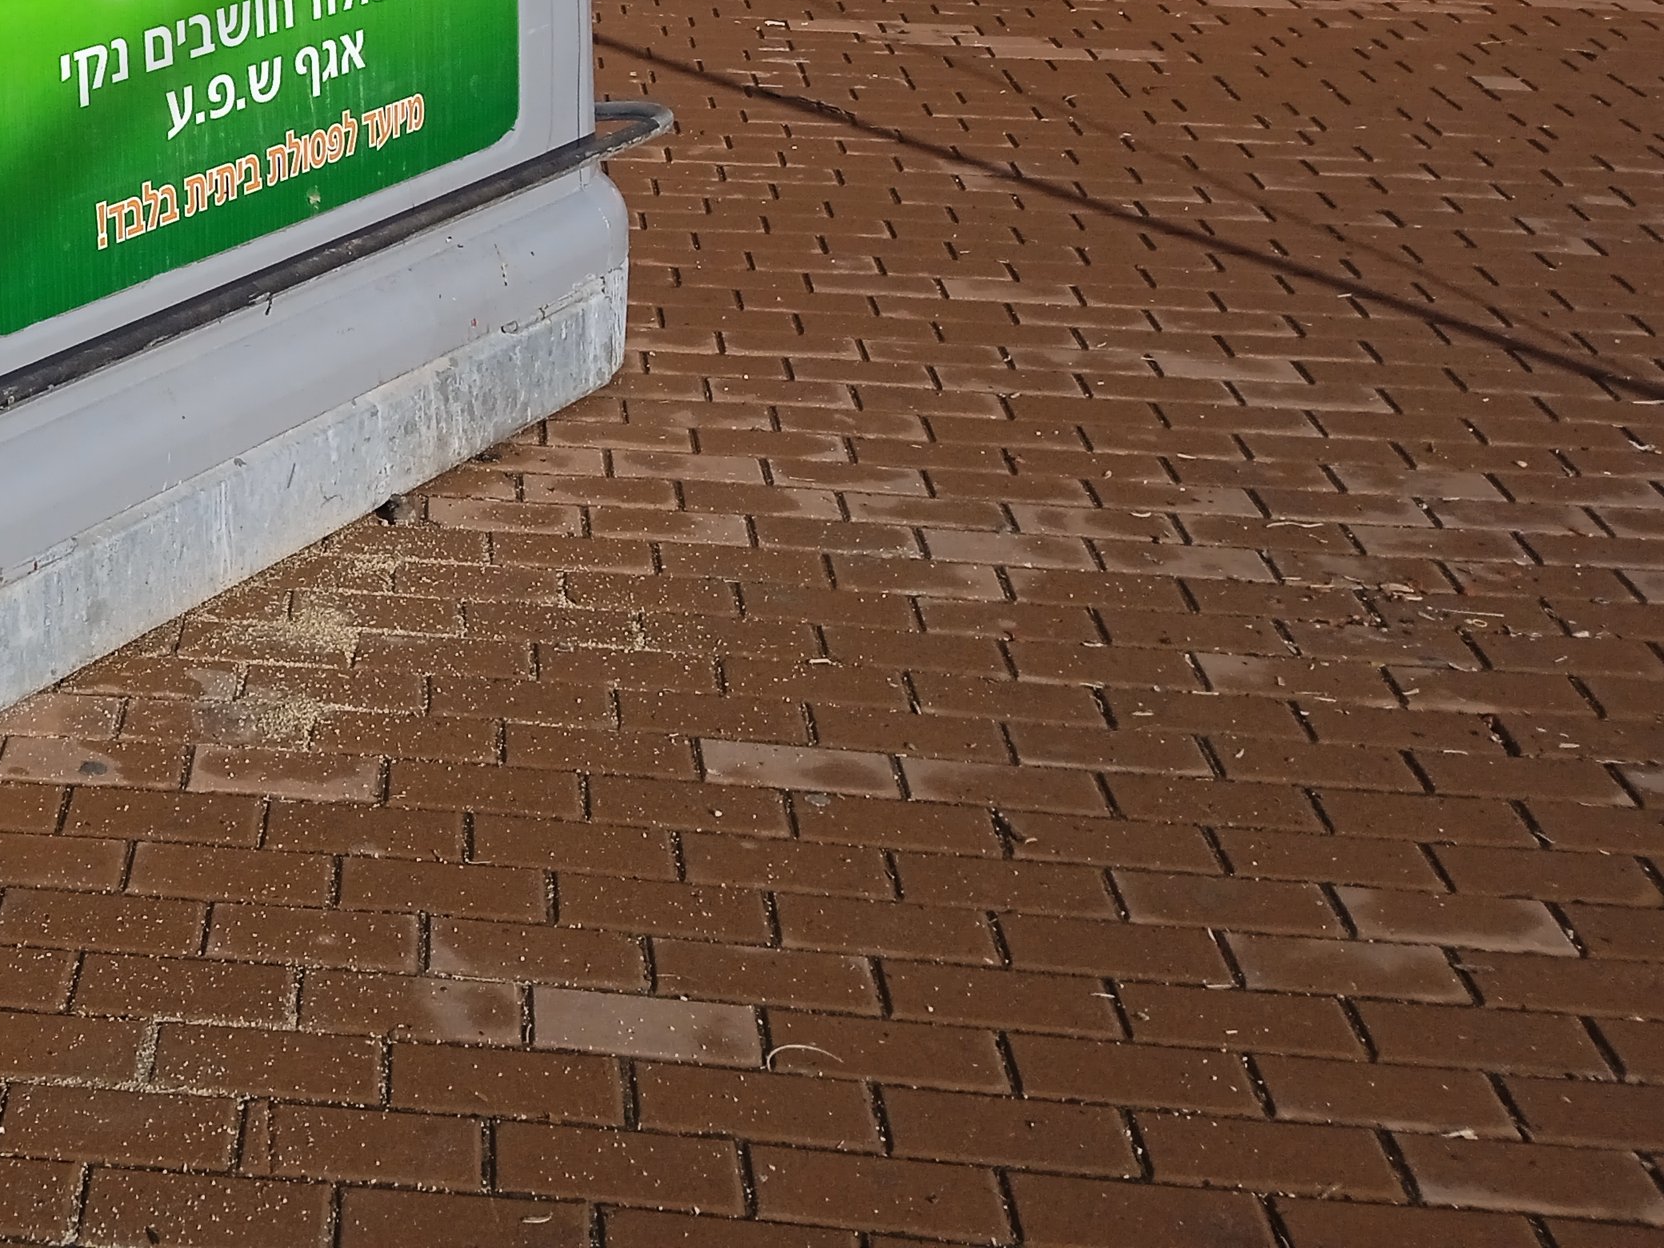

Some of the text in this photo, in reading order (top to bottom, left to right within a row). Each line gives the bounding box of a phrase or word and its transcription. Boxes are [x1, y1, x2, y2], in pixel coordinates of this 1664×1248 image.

[60, 36, 130, 108] נקי
[165, 29, 366, 141] אגף ש.פ.ע
[95, 93, 425, 250] מיועד לפסולת ביתית בלבד!
